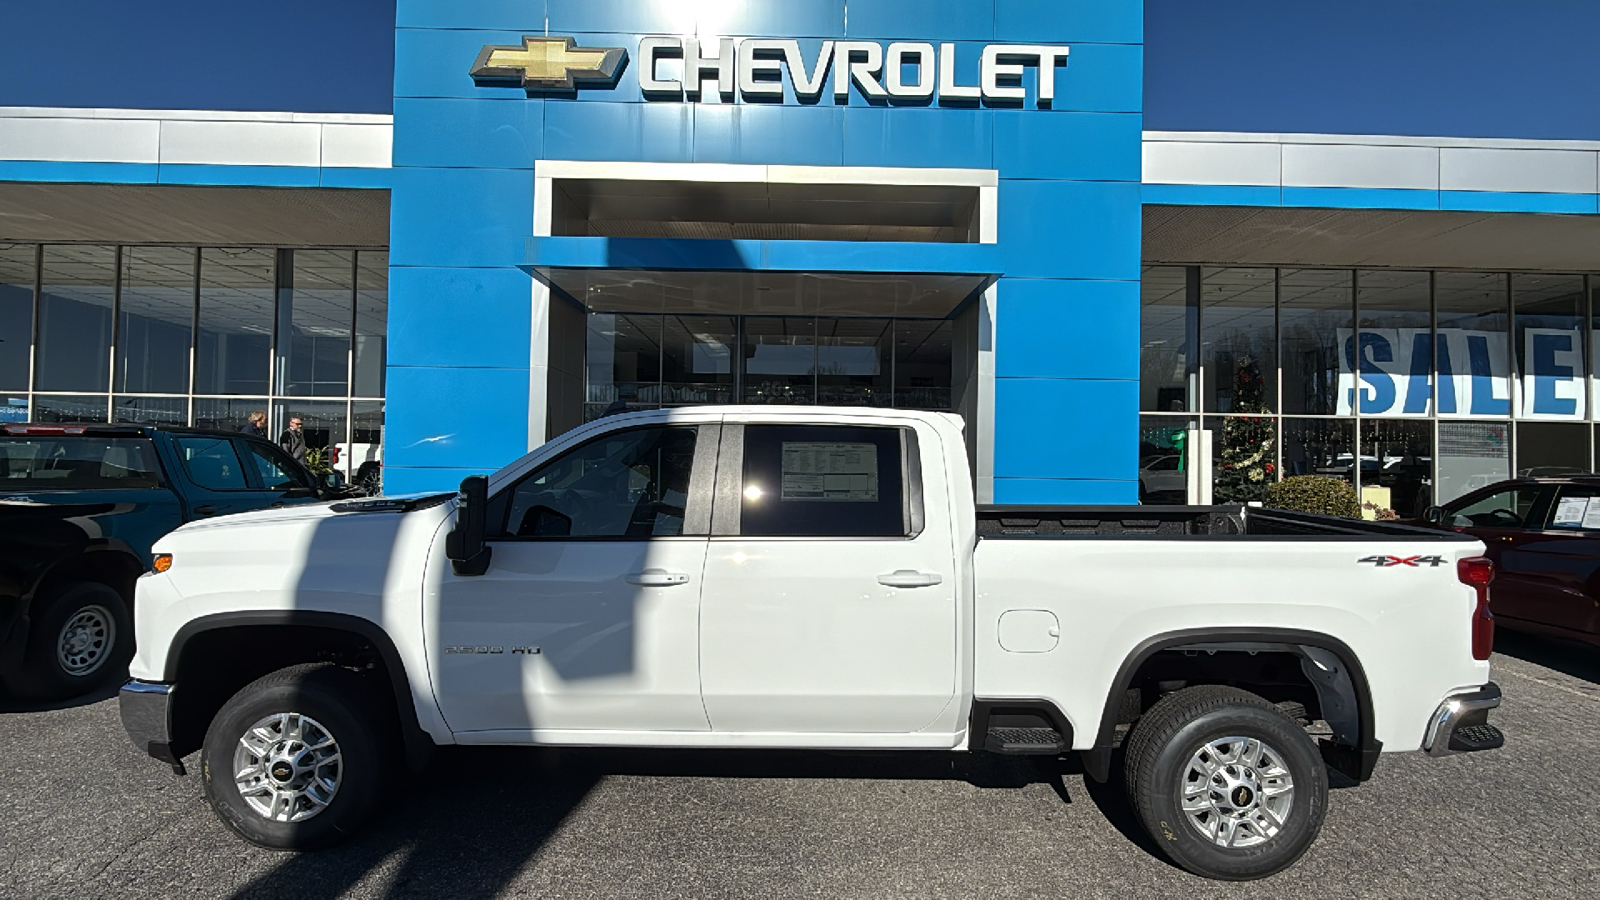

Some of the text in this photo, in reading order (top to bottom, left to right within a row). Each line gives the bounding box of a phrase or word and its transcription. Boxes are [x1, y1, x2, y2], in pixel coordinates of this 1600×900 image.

[638, 37, 1070, 107] CHEVROLET
[1345, 331, 1576, 415] SALE
[444, 646, 541, 654] 2500 HD
